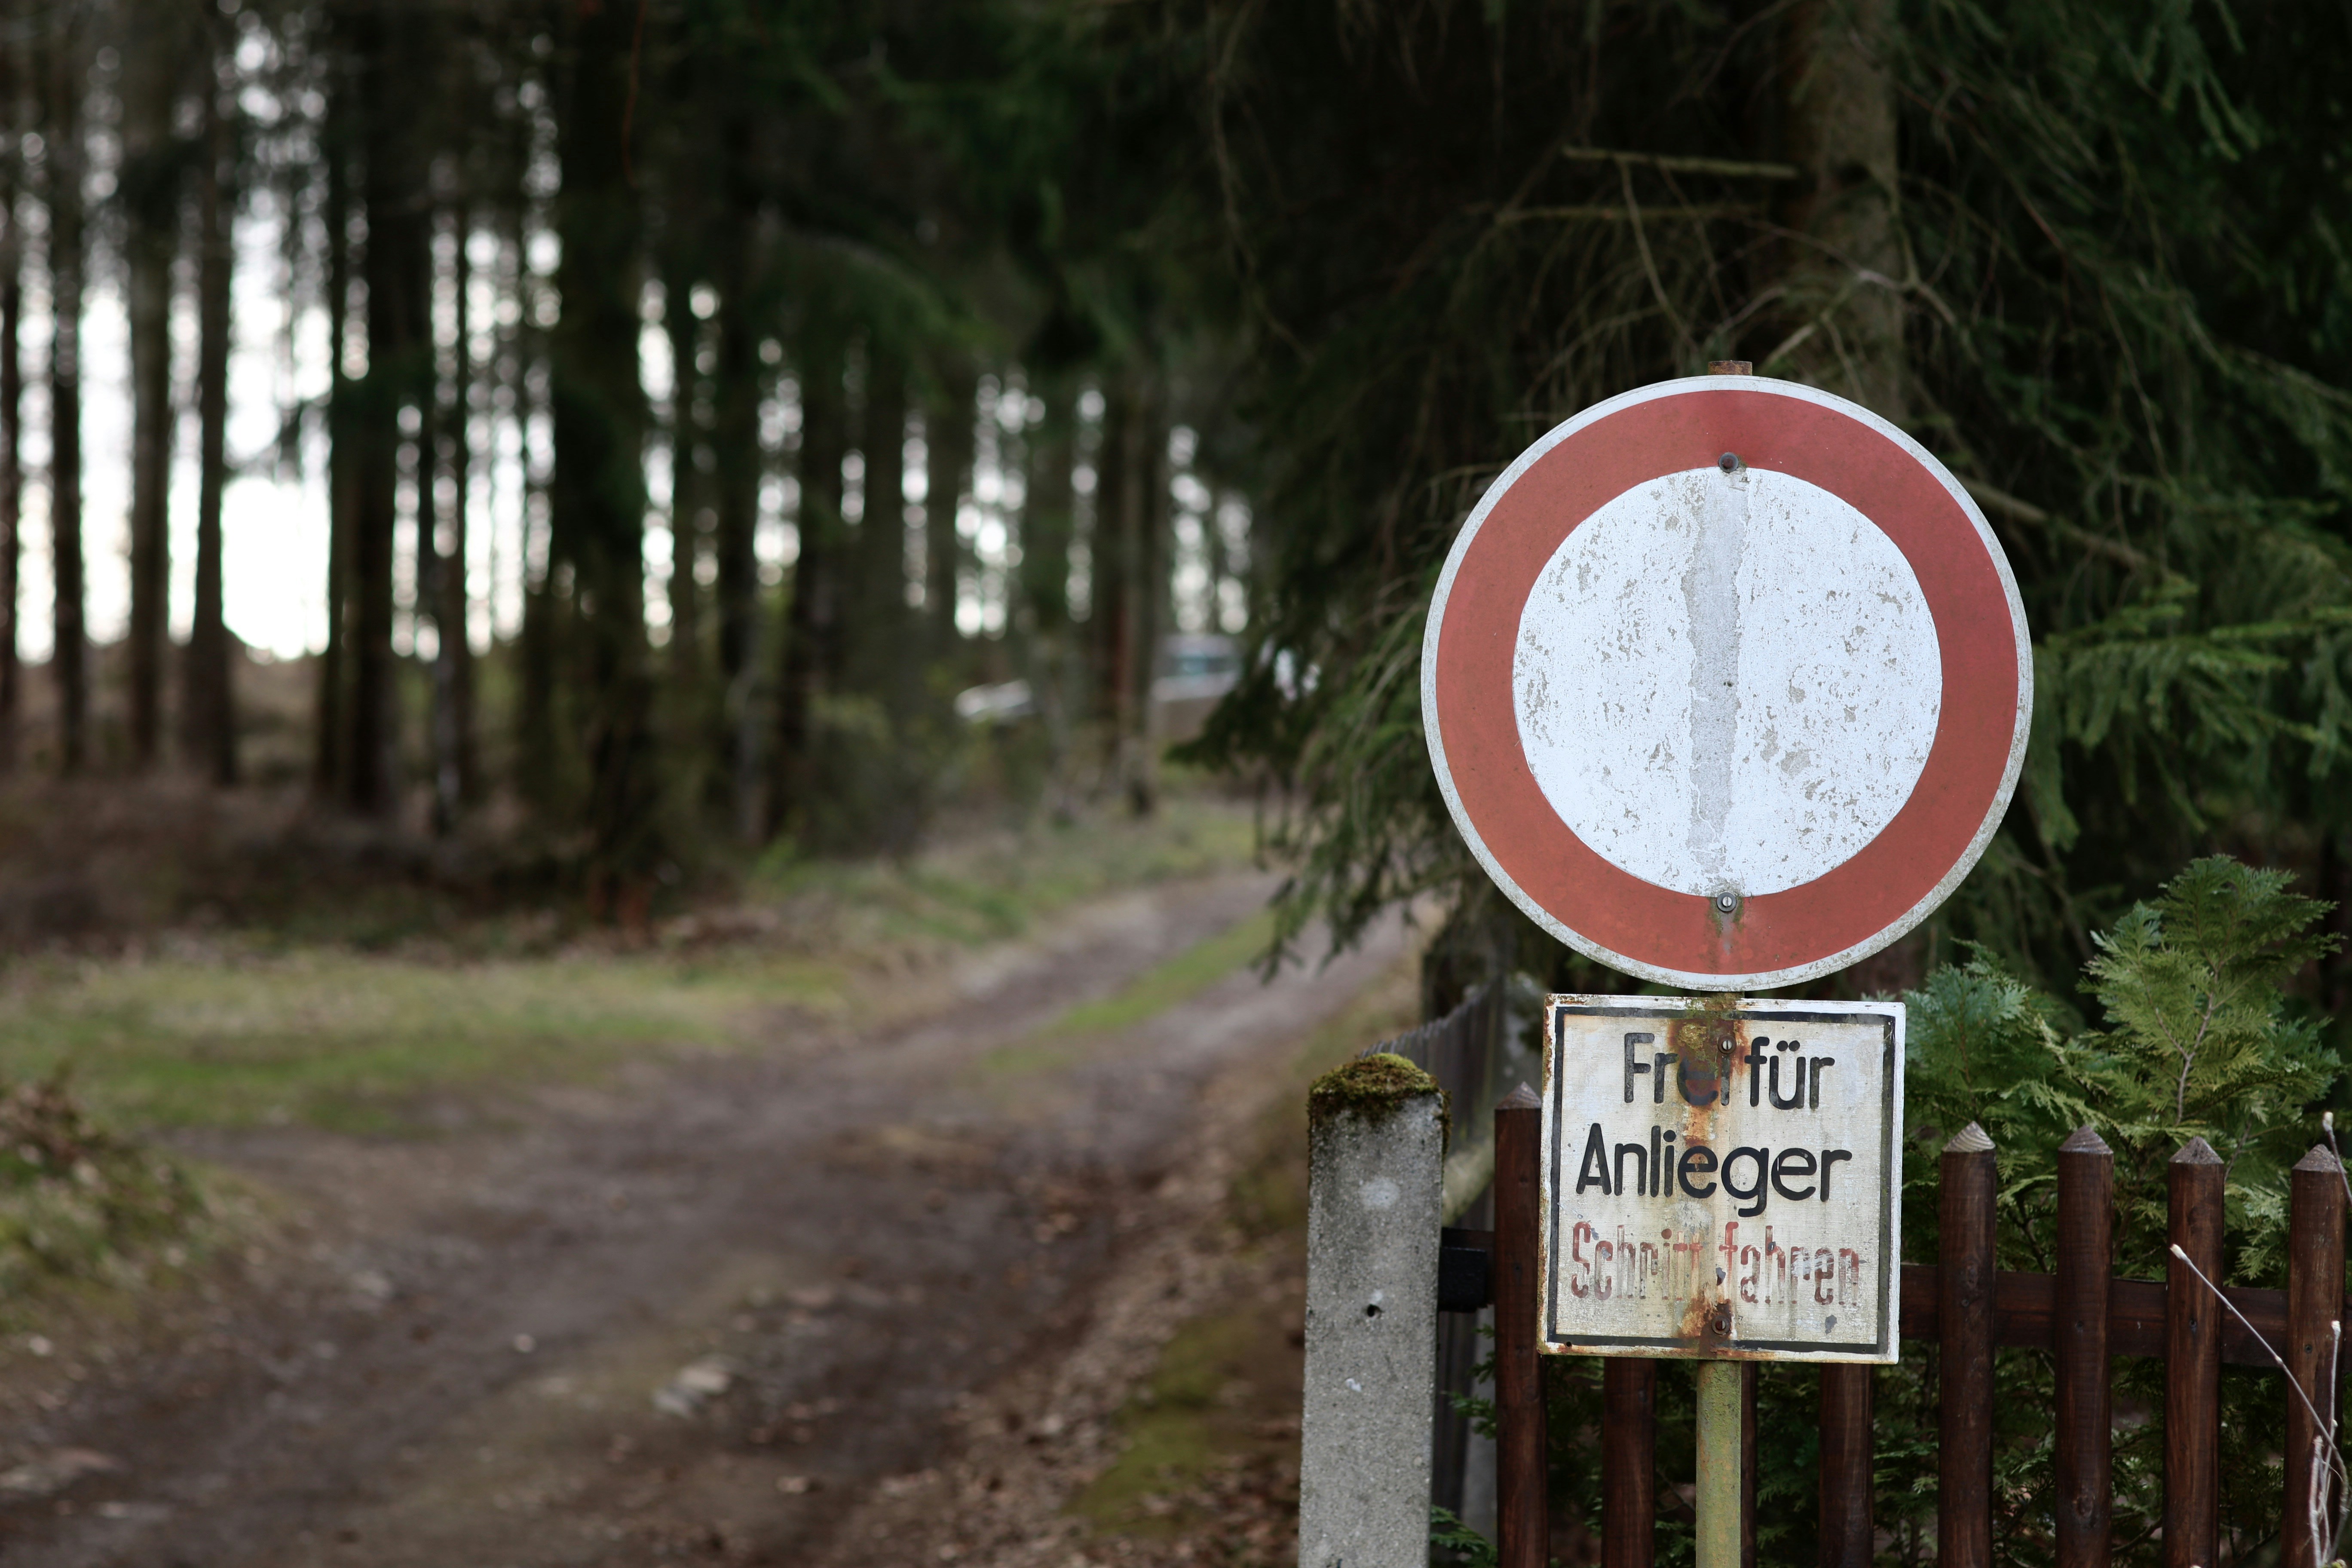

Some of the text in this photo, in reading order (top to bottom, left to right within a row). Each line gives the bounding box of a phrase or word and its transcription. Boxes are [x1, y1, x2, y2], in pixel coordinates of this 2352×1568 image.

[1624, 1032, 1835, 1110] Frei für
[1576, 1123, 1853, 1217] Anlieger
[1571, 1221, 1860, 1307] Schritt fahren
